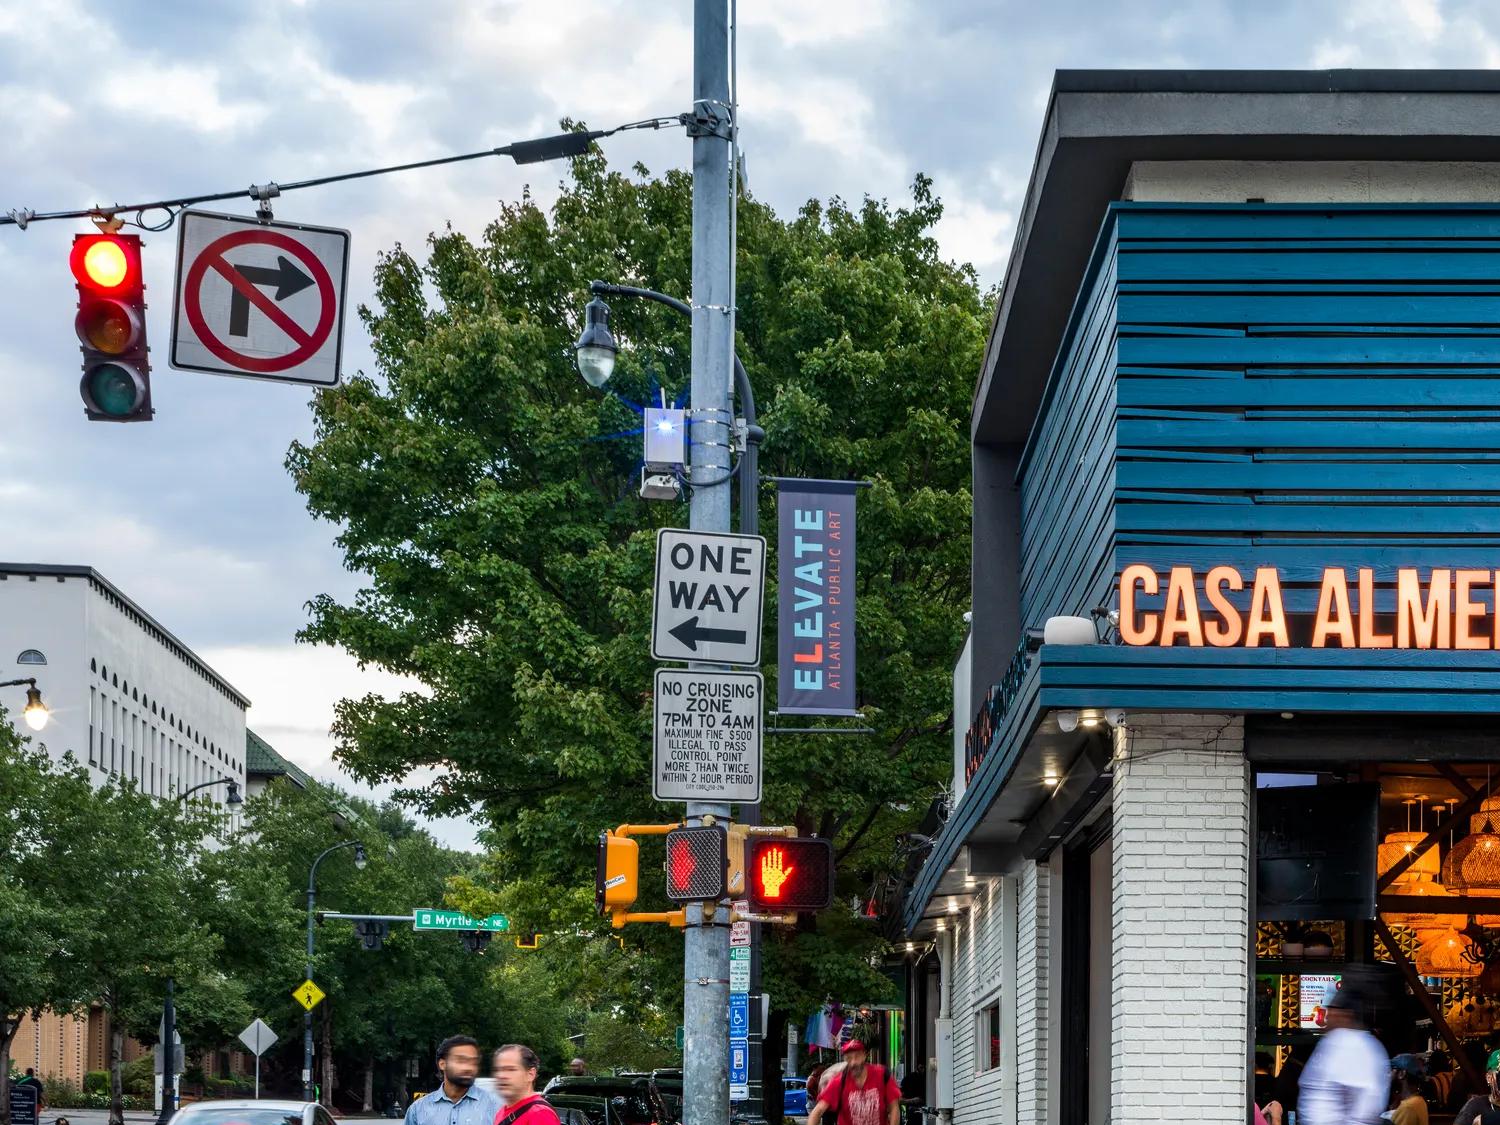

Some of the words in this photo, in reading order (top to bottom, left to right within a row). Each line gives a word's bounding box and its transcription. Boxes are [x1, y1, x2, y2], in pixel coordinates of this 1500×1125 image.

[828, 511, 841, 540] ART
[671, 542, 752, 575] ONE
[828, 548, 841, 605] PUBLIC
[669, 581, 750, 613] WAY
[794, 509, 823, 690] ELEVATE
[1119, 564, 1290, 648] CASA
[828, 621, 841, 690] ATLANTA
[662, 681, 682, 696] NO
[688, 682, 754, 698] CRUISING
[686, 698, 732, 713] ZONE
[662, 713, 692, 727] 7PM
[698, 714, 716, 728] TO
[721, 715, 754, 729] 4AM
[664, 728, 702, 739] MAXIMUM
[706, 730, 723, 740] FINE
[729, 730, 752, 740] $500
[668, 740, 704, 750] ILLEGAL
[709, 741, 719, 750] TO
[725, 741, 747, 751] PASS
[671, 751, 712, 761] CONTROL
[716, 752, 743, 762] POINT
[665, 762, 690, 772] MORE
[696, 762, 718, 773] THAN
[723, 763, 749, 774] TWICE
[662, 772, 687, 783] WITHIN
[691, 773, 697, 783] 2
[700, 774, 722, 784] HOUR
[725, 774, 754, 785] PERIOD
[435, 914, 472, 927] Myrtle
